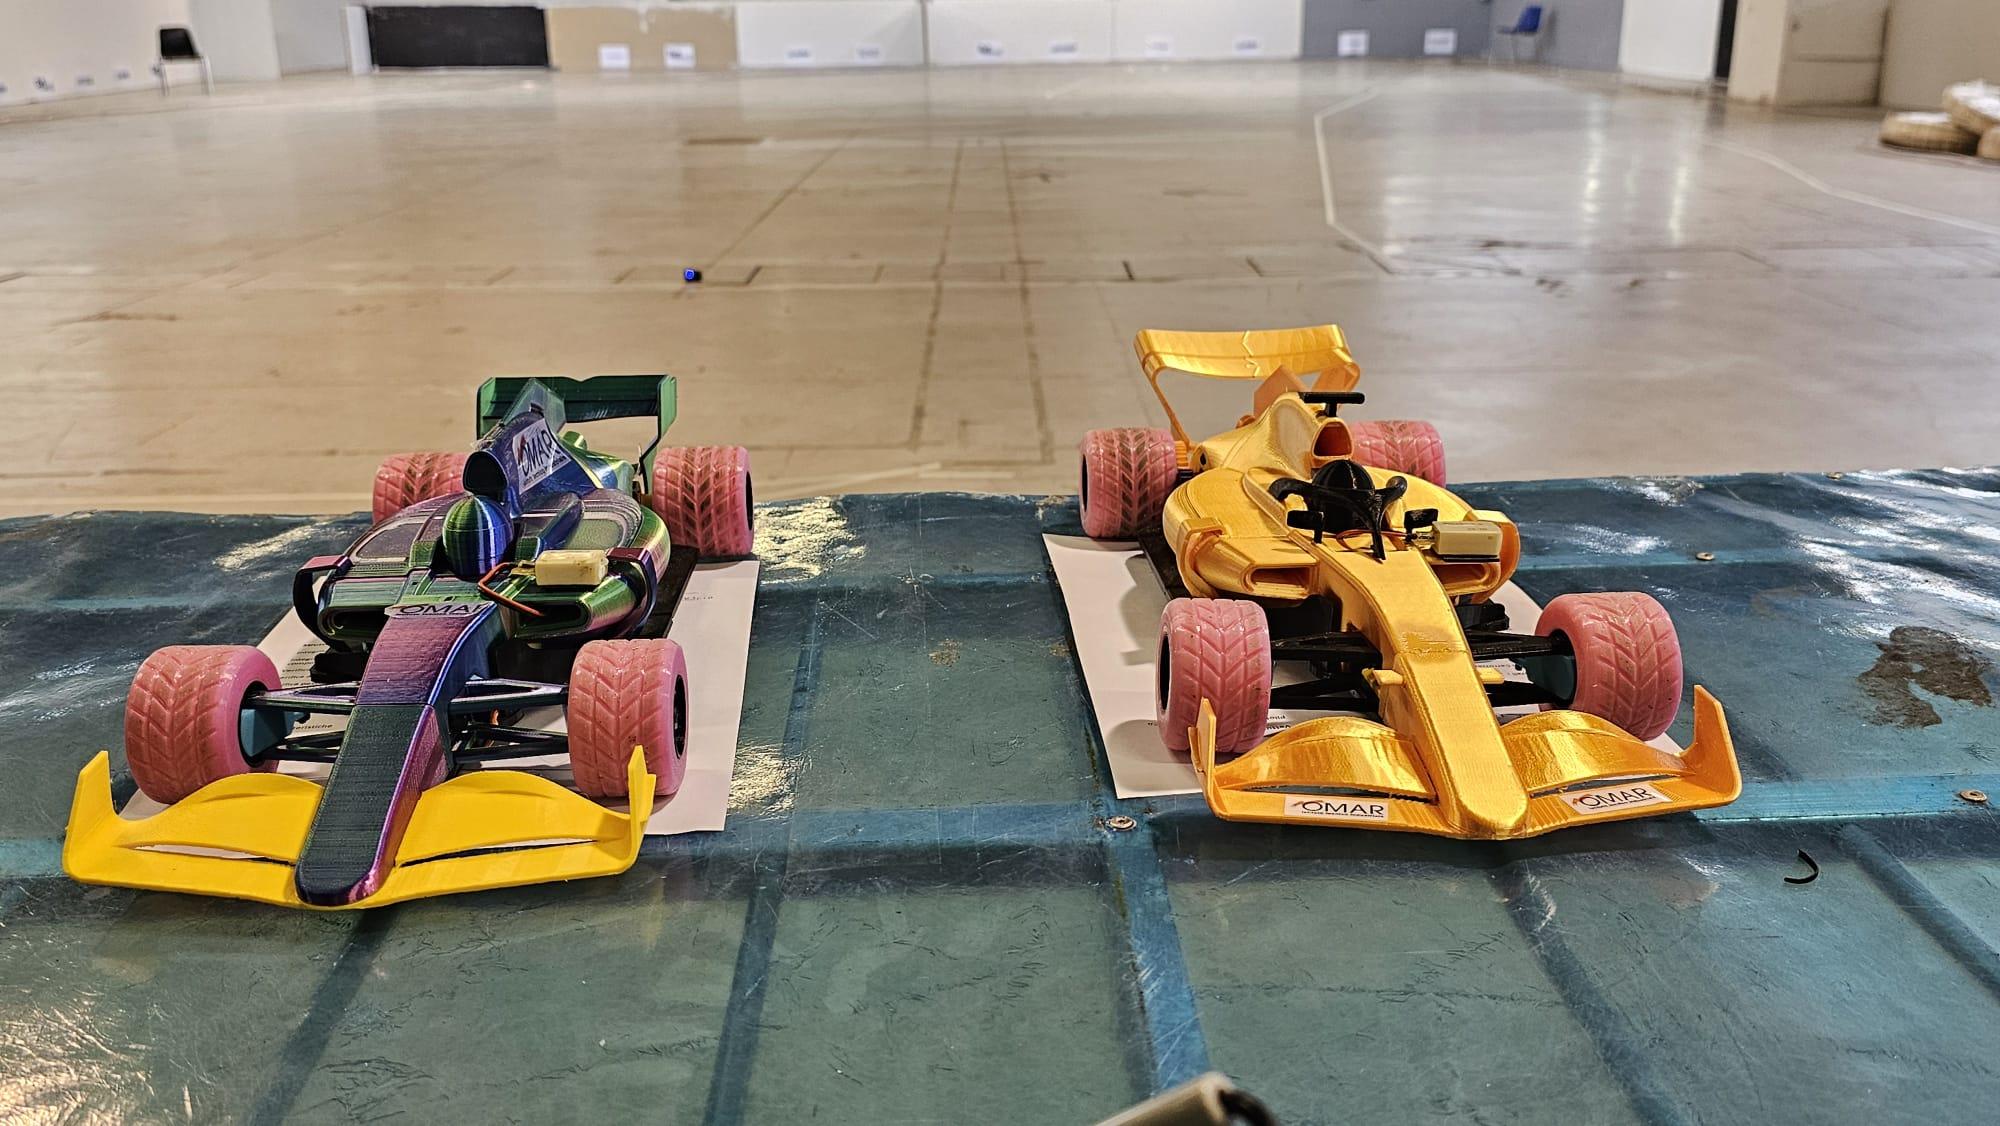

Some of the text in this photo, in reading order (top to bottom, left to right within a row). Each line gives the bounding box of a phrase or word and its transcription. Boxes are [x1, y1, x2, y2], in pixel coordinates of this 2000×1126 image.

[519, 429, 561, 477] OMAR
[1580, 787, 1651, 807] OMAR
[1302, 801, 1384, 815] OMAR
